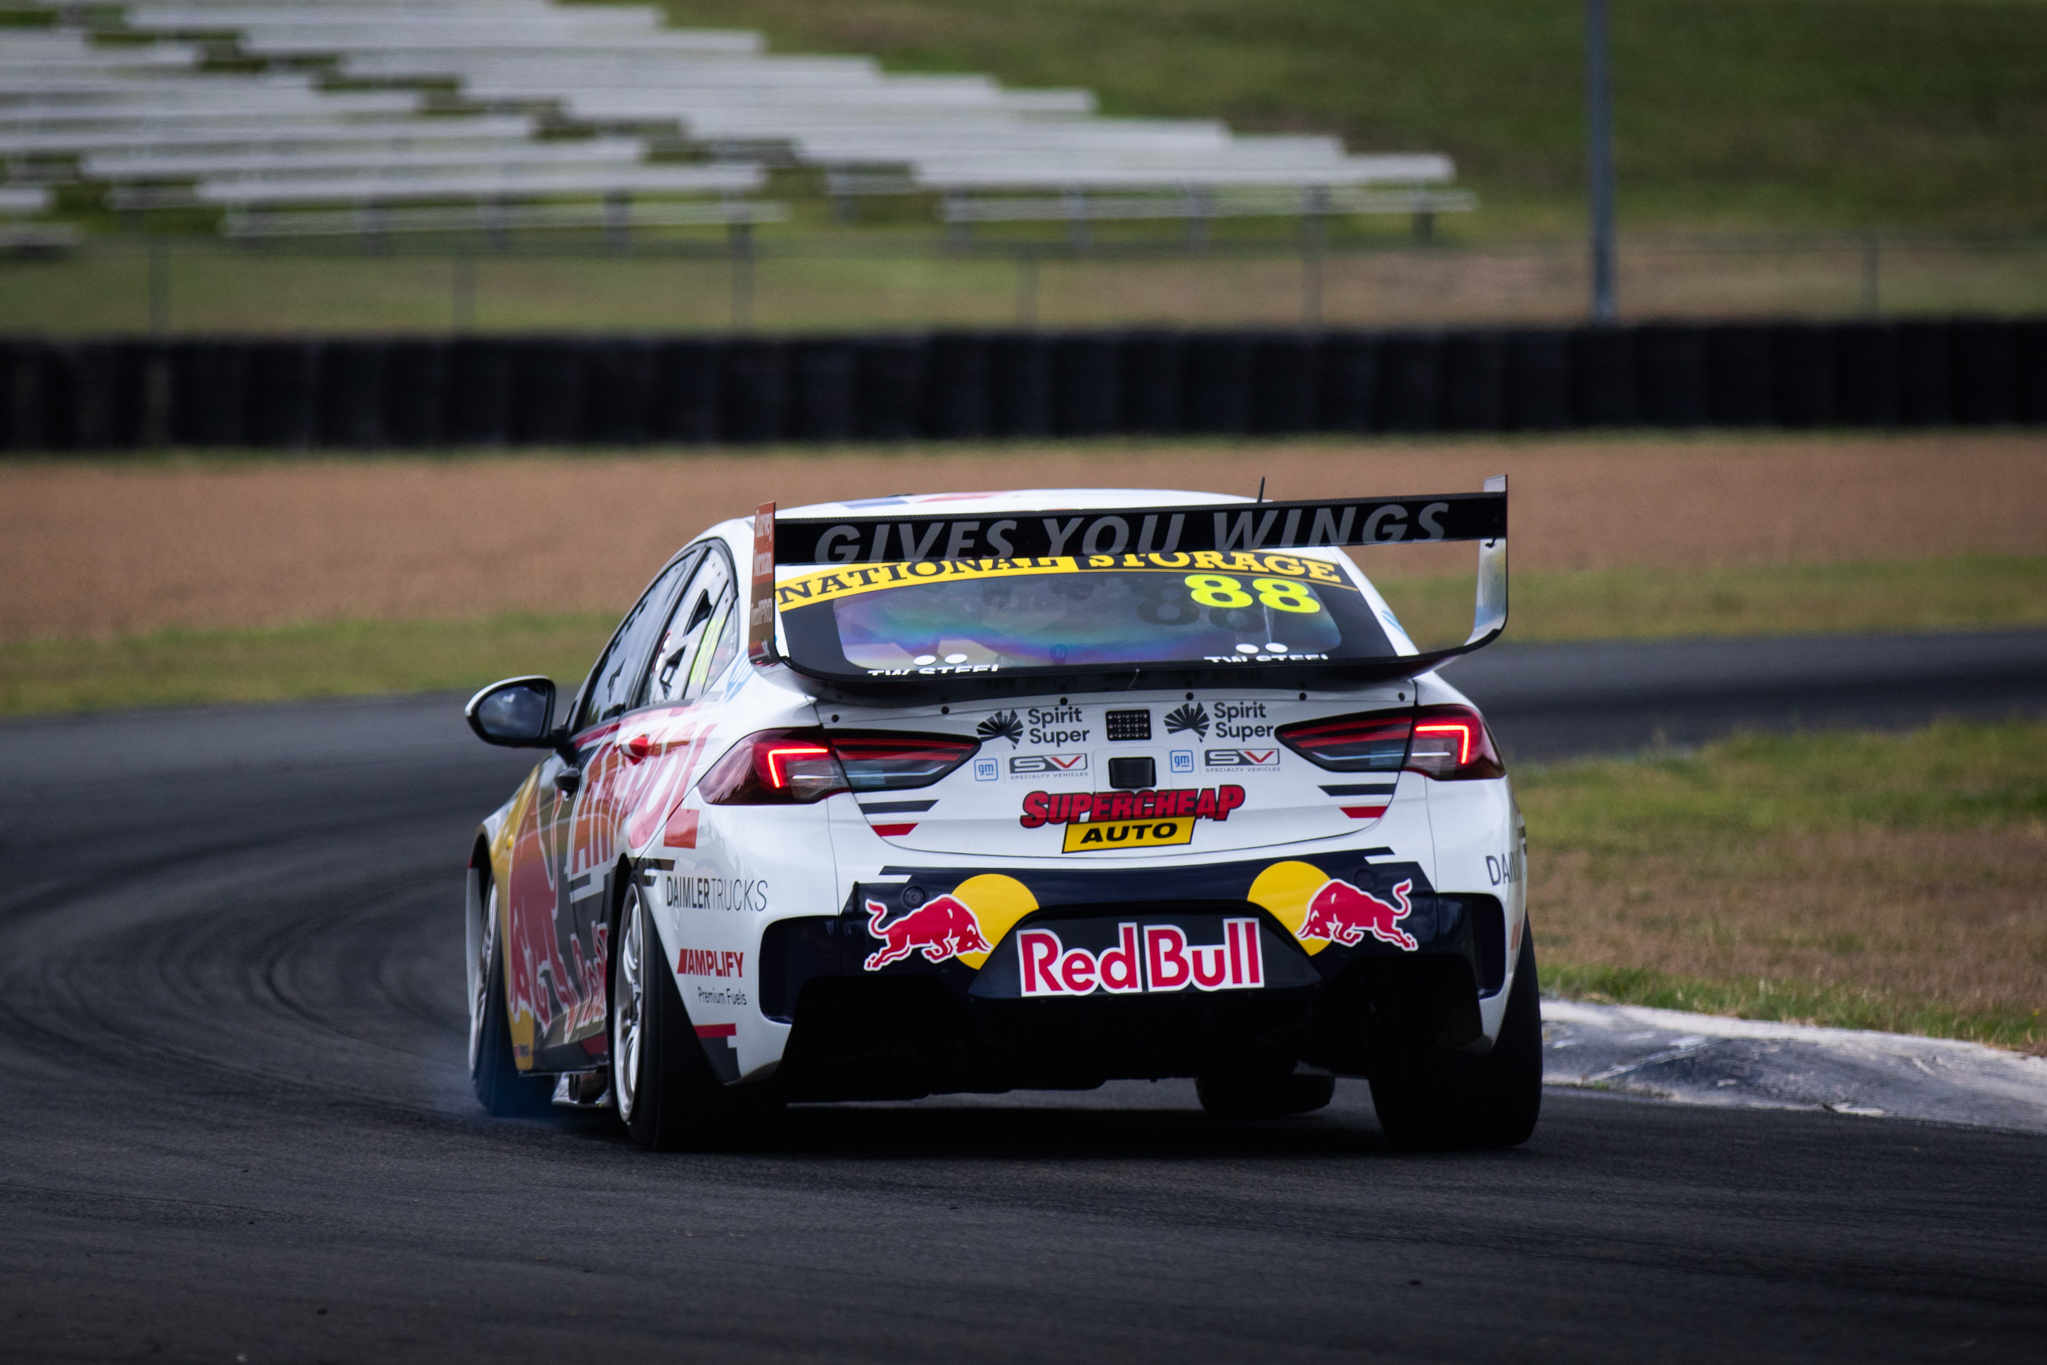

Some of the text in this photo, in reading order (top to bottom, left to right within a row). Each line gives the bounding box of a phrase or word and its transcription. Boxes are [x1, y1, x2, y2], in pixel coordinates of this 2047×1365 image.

[814, 502, 1450, 565] GIVES YOU WINGS
[1183, 574, 1321, 614] 88
[1028, 706, 1083, 728] Spirit
[1214, 701, 1267, 723] Spirit
[1029, 728, 1090, 747] Super
[1215, 721, 1274, 742] Super
[1012, 754, 1084, 772] SV
[1174, 754, 1190, 768] gm
[1208, 750, 1276, 765] SV
[978, 763, 994, 776] gm
[1020, 784, 1246, 828] SUPERCHEAP
[1080, 822, 1178, 844] AUTO
[685, 949, 744, 977] AMPLIFY
[1017, 918, 1265, 997] Red Bull
[697, 986, 748, 1006] Premium Fuels
